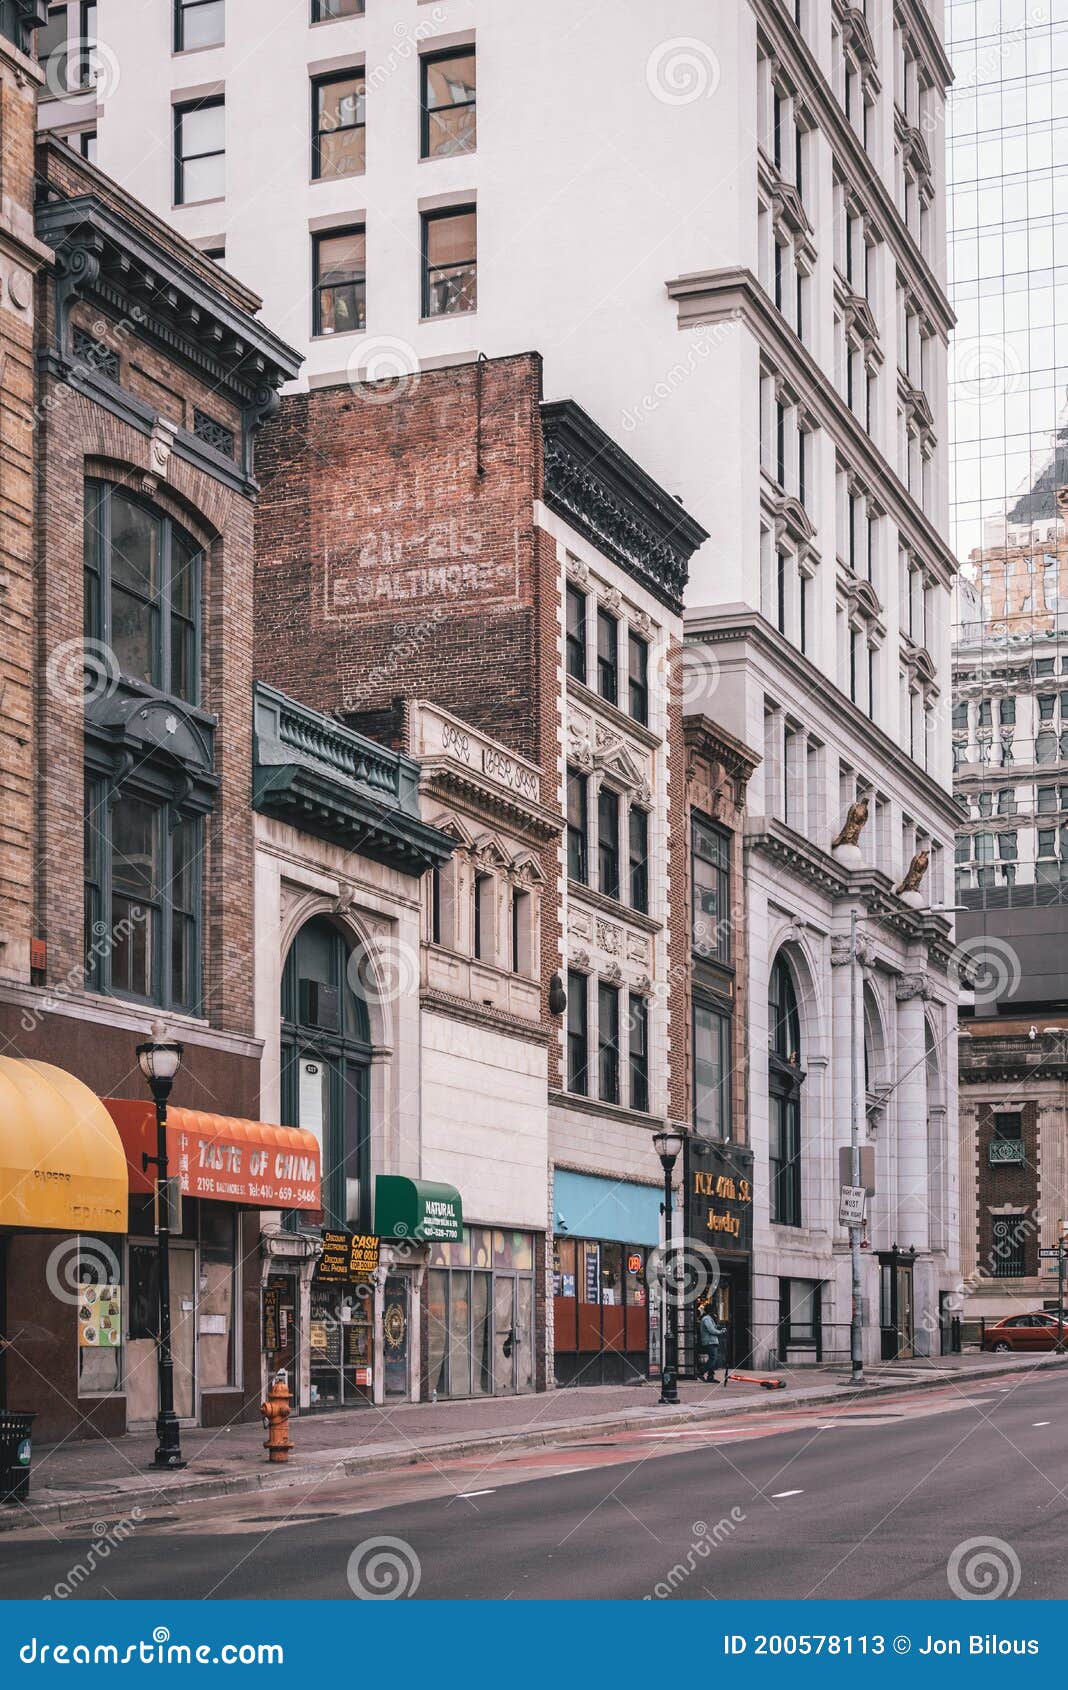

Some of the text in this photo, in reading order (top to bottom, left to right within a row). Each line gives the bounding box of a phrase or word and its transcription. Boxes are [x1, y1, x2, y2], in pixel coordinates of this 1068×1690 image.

[198, 1139, 316, 1182] TASTE OF CHINA
[425, 1200, 456, 1217] NATURAL
[707, 1208, 739, 1237] Jewelry
[352, 1235, 379, 1249] CASH
[352, 1249, 378, 1260] FOR GOLD
